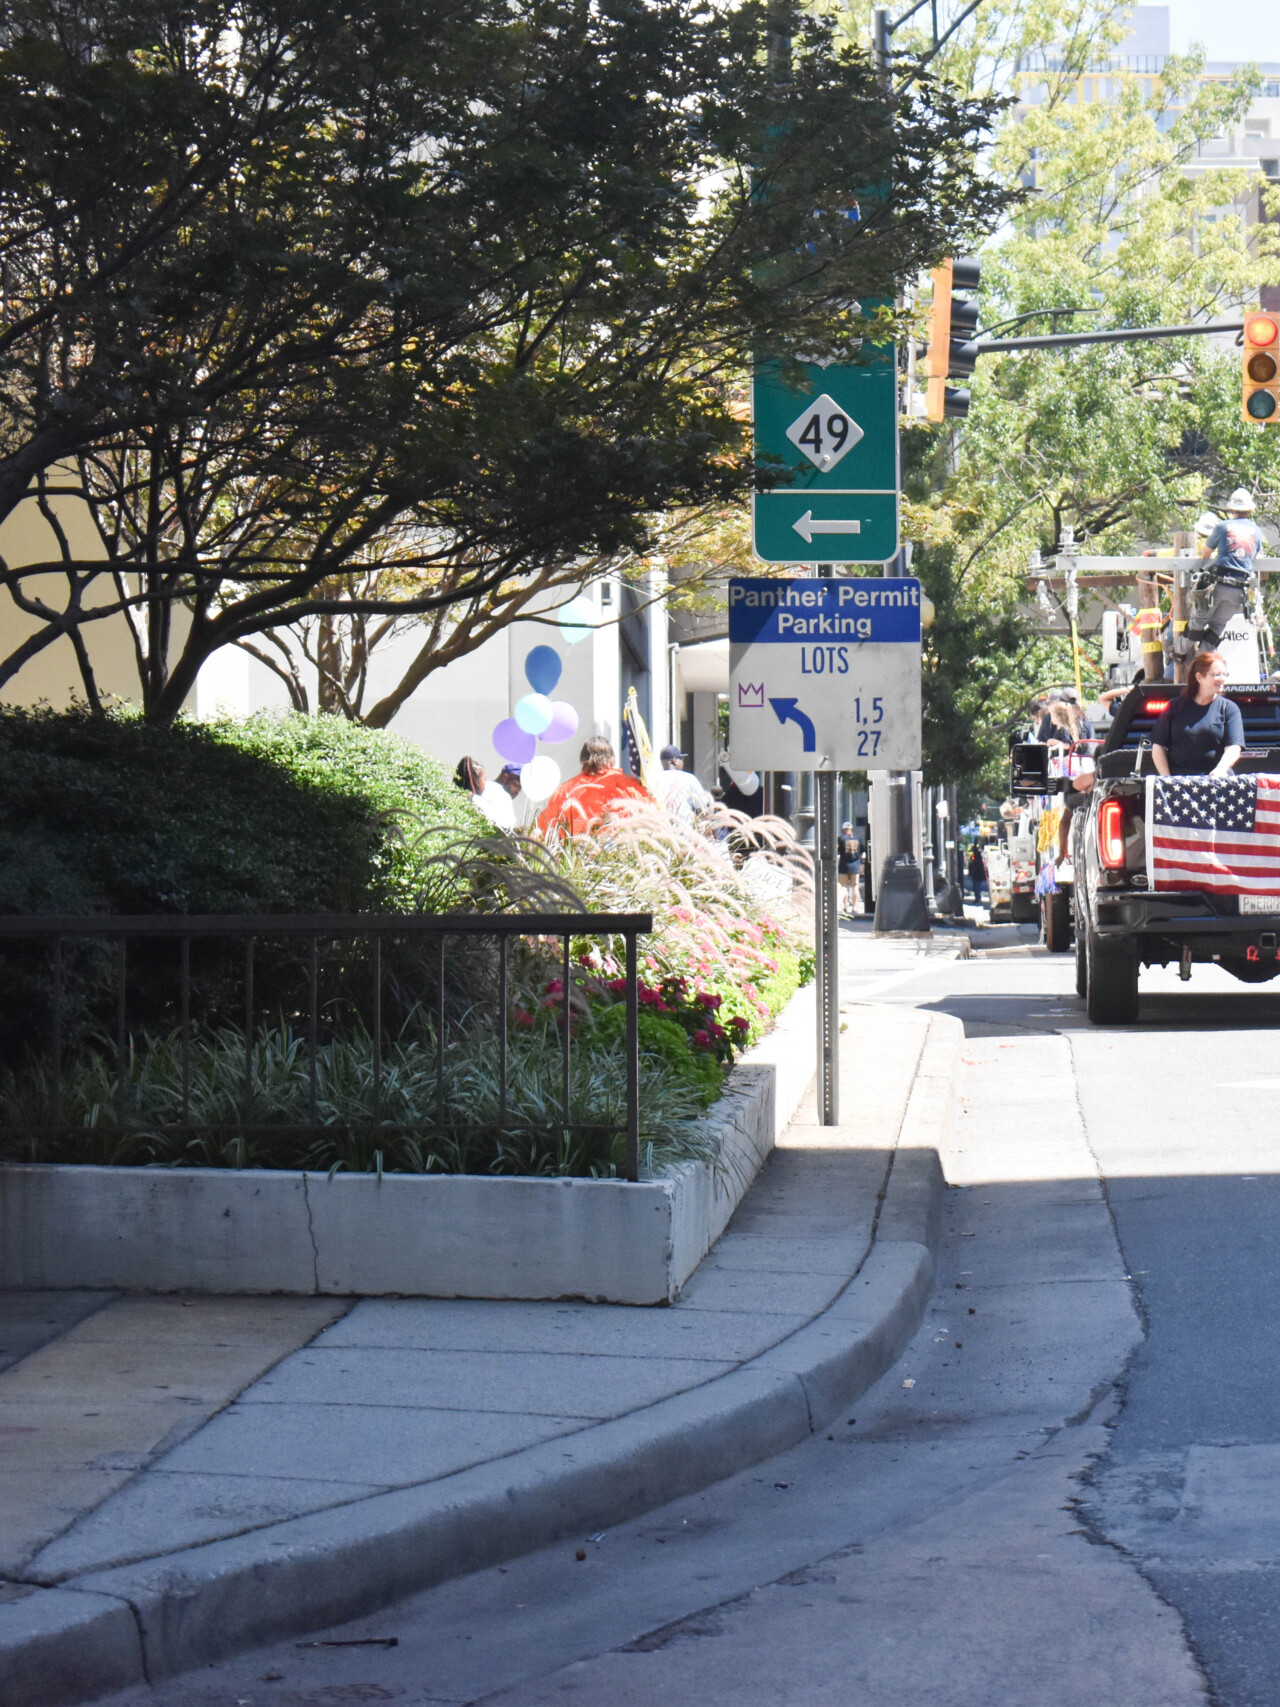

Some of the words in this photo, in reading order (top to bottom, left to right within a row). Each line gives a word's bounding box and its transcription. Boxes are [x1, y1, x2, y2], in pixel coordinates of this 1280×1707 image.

[798, 413, 849, 455] 49
[729, 586, 824, 608] Panther
[838, 586, 919, 607] Permit
[777, 613, 872, 638] Parking
[1223, 630, 1250, 641] Altec
[800, 646, 849, 674] LOTS
[856, 731, 882, 757] 27
